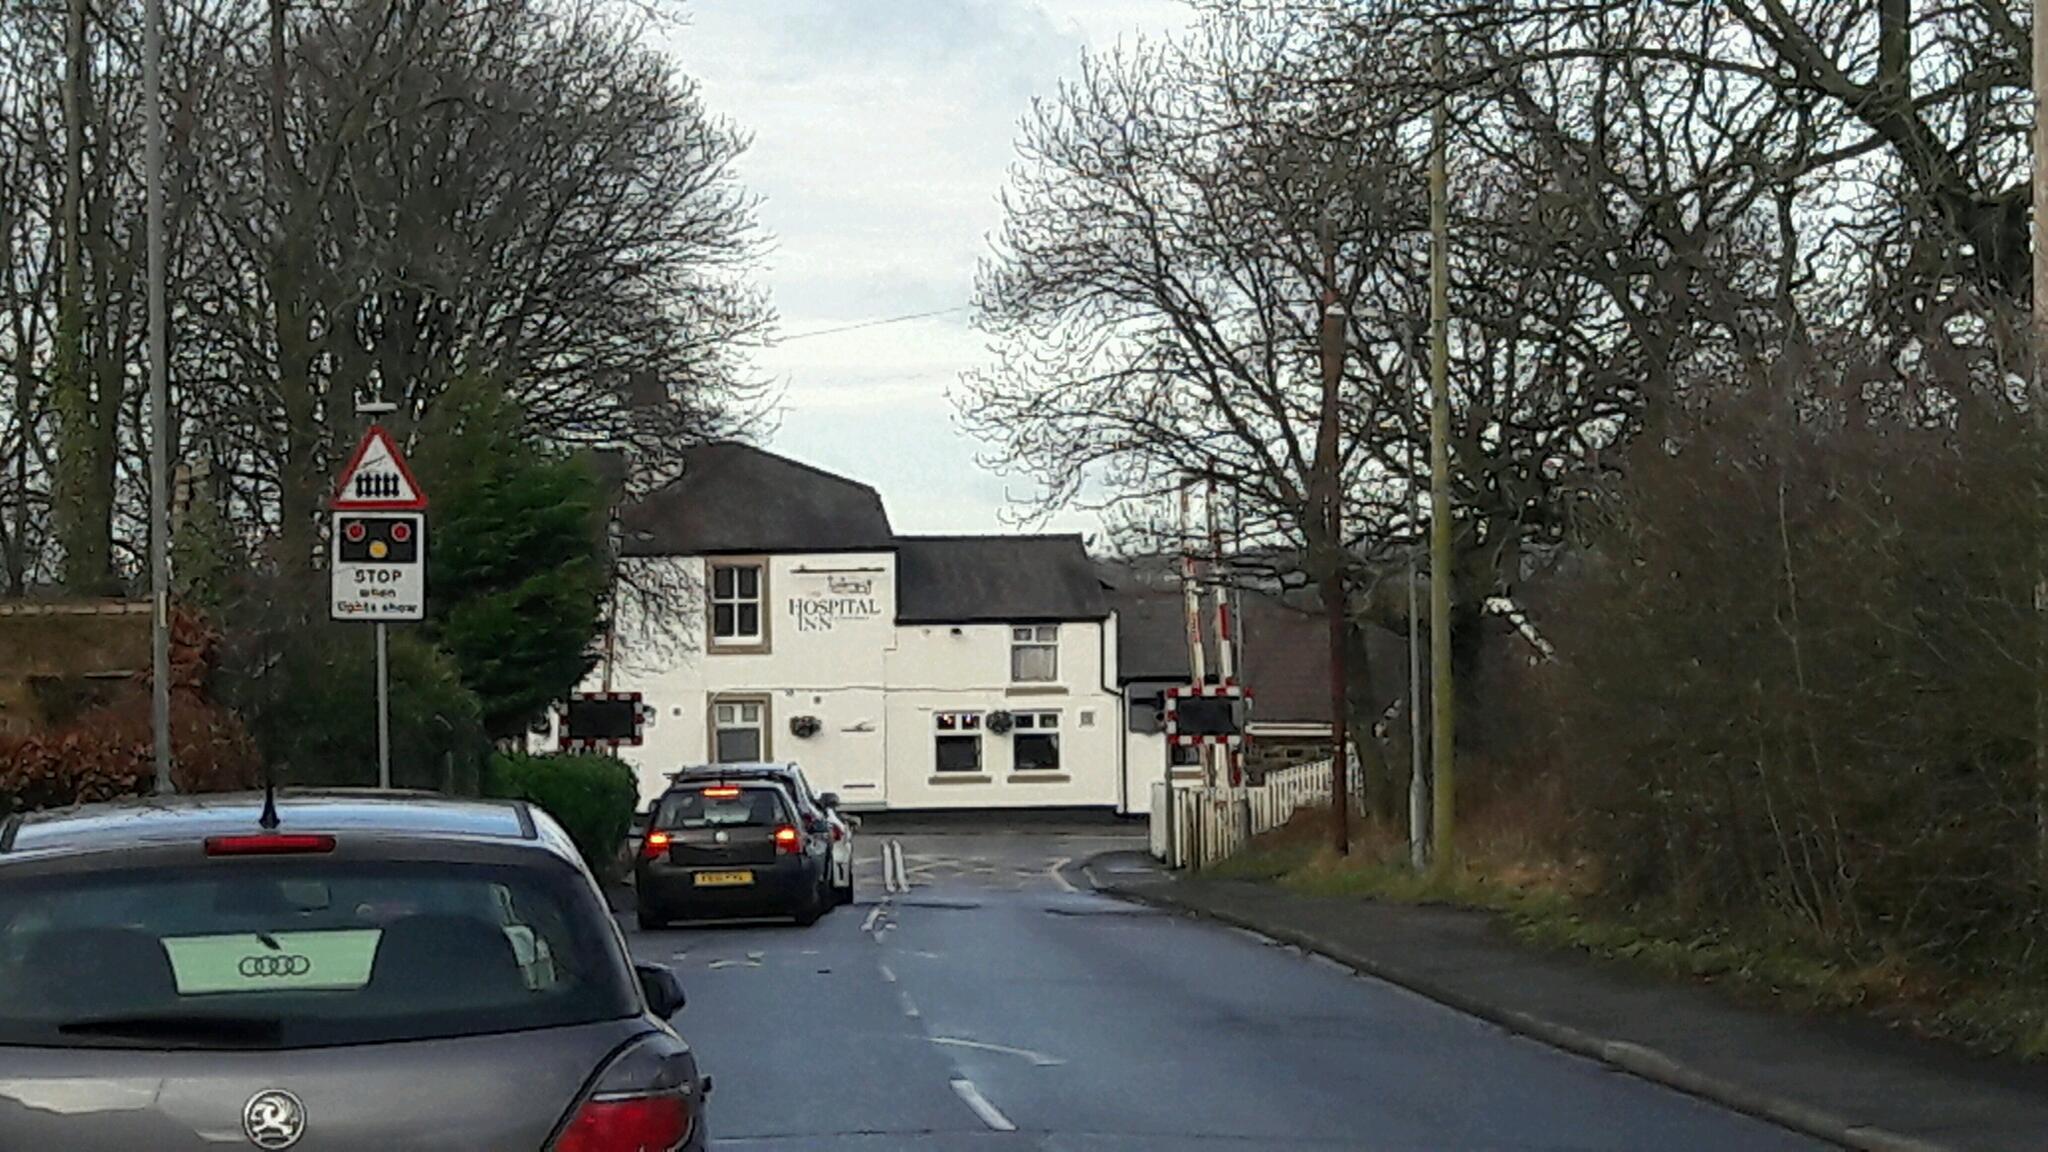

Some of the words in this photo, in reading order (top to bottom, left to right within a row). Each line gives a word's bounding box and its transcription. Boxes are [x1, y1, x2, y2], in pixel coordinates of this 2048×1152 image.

[354, 569, 402, 583] STOP
[789, 598, 881, 615] HOSPITAL
[798, 615, 832, 631] INN
